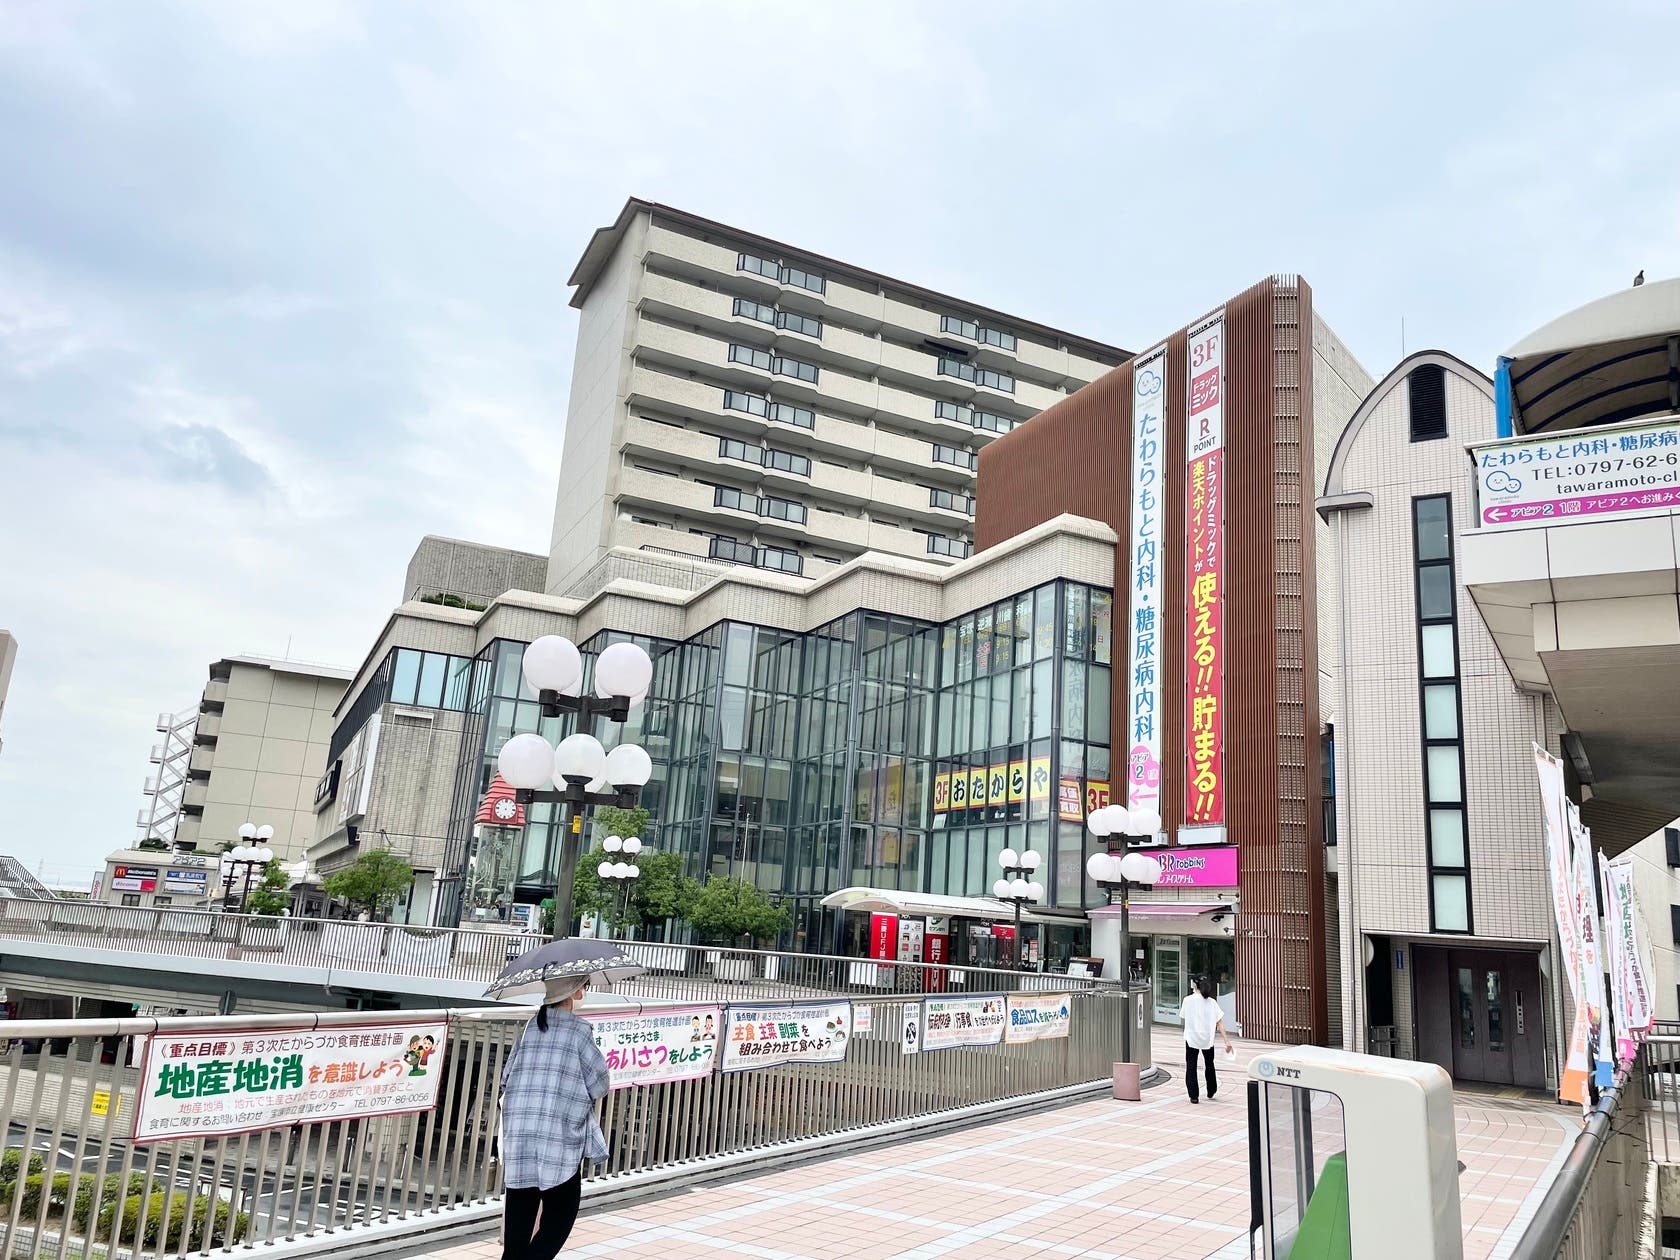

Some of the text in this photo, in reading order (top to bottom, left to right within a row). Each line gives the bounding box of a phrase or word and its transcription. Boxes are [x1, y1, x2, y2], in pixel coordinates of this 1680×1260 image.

[1193, 335, 1219, 367] 3F
[1192, 385, 1218, 409] ミック
[1193, 436, 1216, 453] POINT
[1192, 461, 1205, 572] 楽天ポイントが
[1206, 455, 1218, 568] ドラッグミックで
[1135, 413, 1157, 742] たわらもと内科・糖尿病内科
[935, 766, 1048, 805] 3F おたからや
[1176, 856, 1206, 870] robbins
[241, 1032, 404, 1055] 第3次たからづか食育推進計画
[739, 1037, 832, 1057] 組み合わせて食べよう
[1276, 1066, 1301, 1079] NTT
